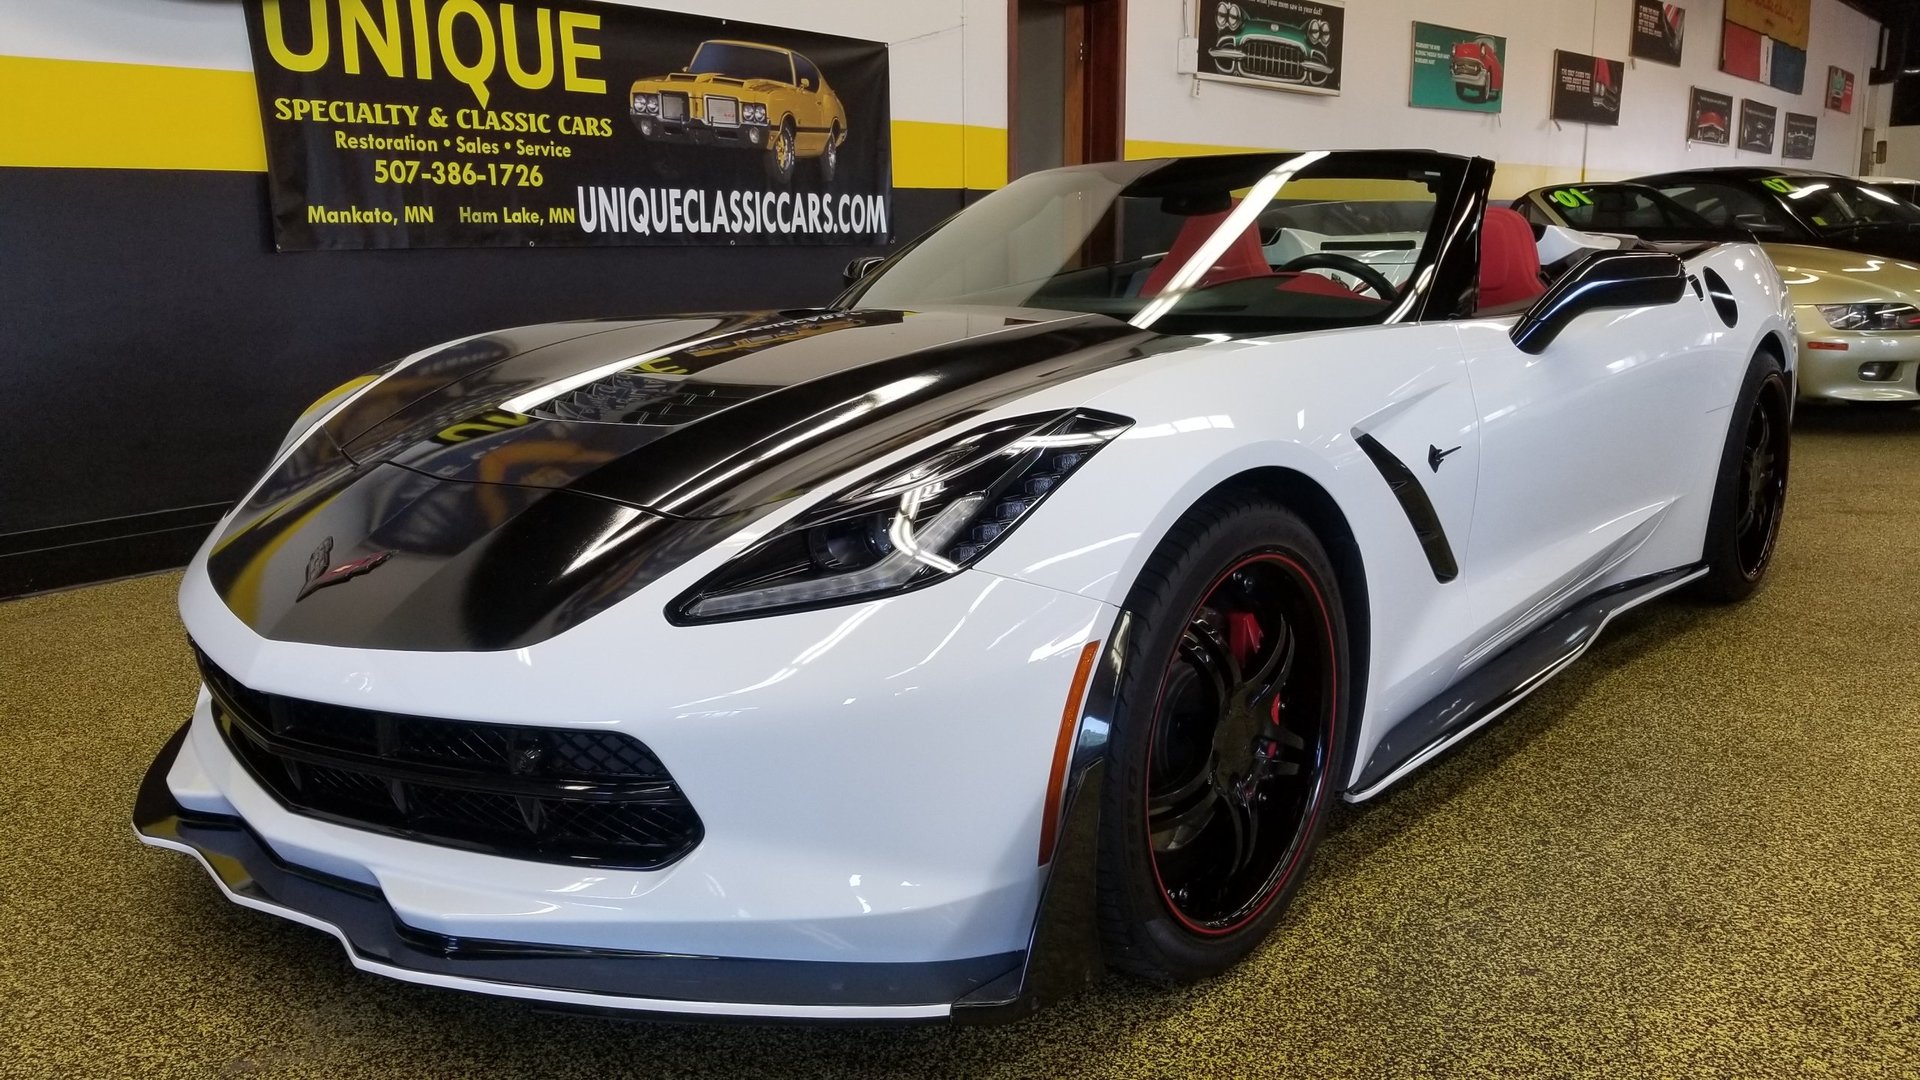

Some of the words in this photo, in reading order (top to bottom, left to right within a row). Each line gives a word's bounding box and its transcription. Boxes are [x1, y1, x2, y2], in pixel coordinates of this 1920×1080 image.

[262, 0, 607, 110] UNIQUE
[274, 98, 420, 126] SPECIALTY
[428, 107, 449, 128] &
[456, 108, 551, 133] CLASSIC
[558, 115, 613, 137] CARS
[334, 130, 438, 152] Restoration
[456, 136, 500, 155] Sales
[516, 139, 572, 158] Service
[374, 159, 544, 187] 507-386-1726
[307, 205, 398, 226] Mankato,
[404, 206, 434, 223] MN
[459, 207, 498, 224] Ham
[503, 207, 544, 226] Lake,
[549, 208, 575, 224] MN
[577, 186, 888, 237] UNIQUECLASSICCARS.COM
